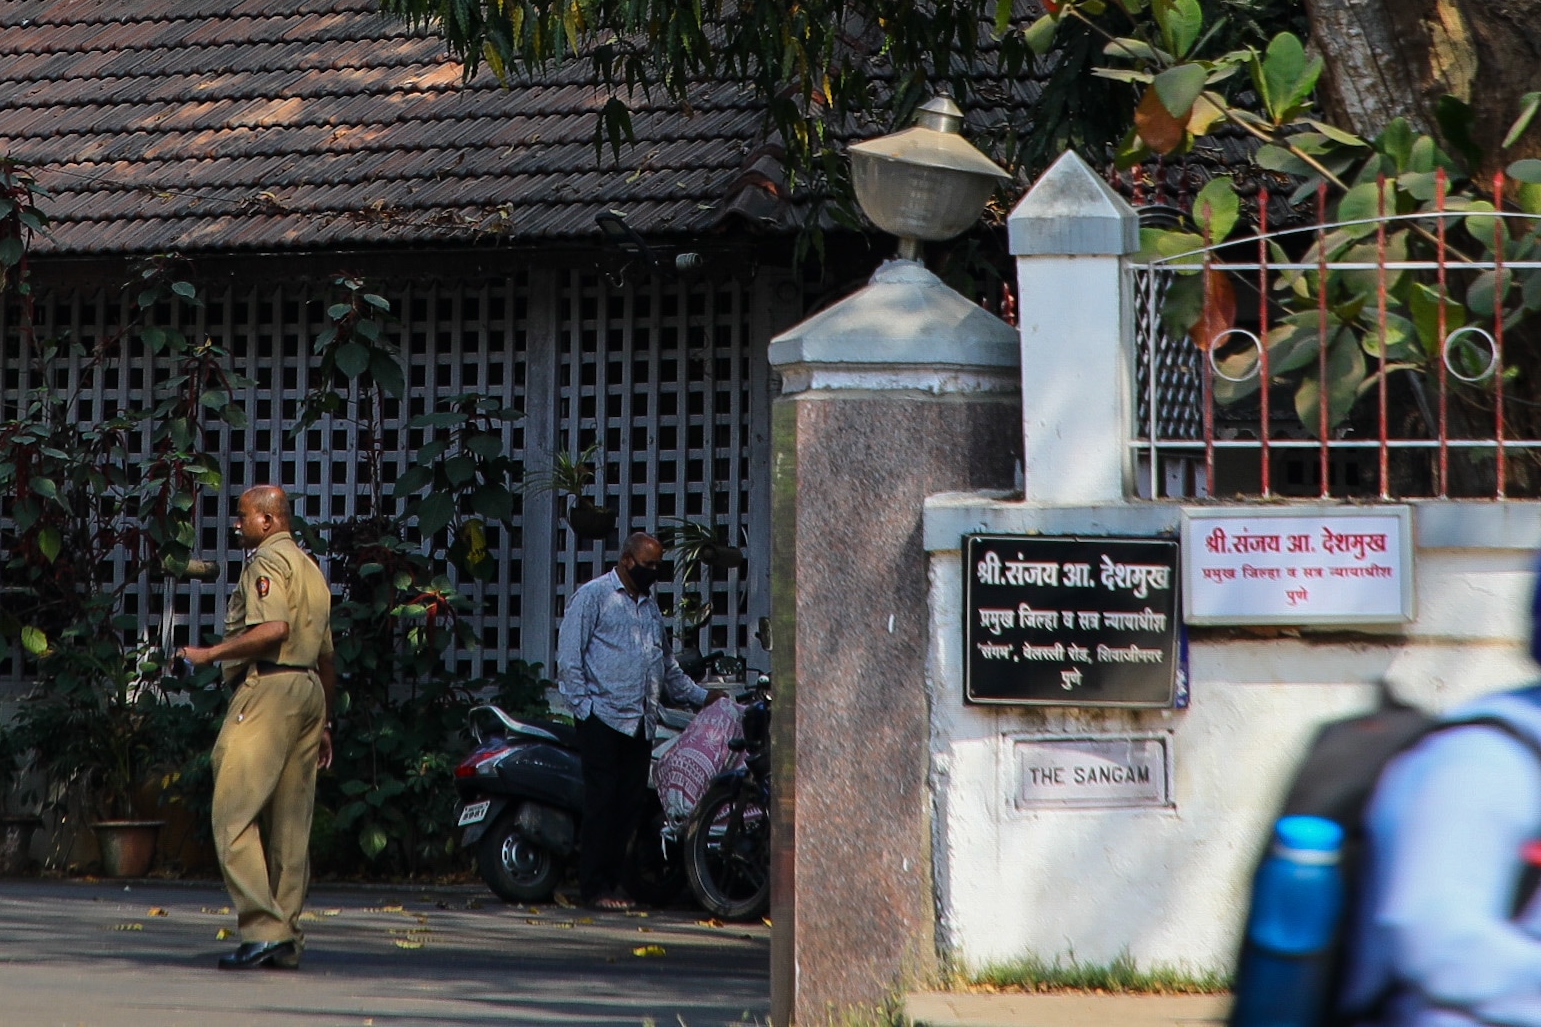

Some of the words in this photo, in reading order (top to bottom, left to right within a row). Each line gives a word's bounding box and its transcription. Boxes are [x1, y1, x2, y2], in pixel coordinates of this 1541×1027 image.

[1287, 534, 1315, 553] आ.
[1322, 527, 1387, 559] देशमुख
[1062, 563, 1095, 588] आ.
[1100, 554, 1171, 599] देशमुख
[1202, 567, 1236, 583] प्रमुख
[1286, 586, 1309, 606] पुणे
[978, 607, 1015, 636] प्रमुख
[1018, 602, 1059, 632] जिल्हा
[1061, 611, 1075, 630] व
[1060, 666, 1083, 692] पुणे
[1029, 766, 1066, 786] THE
[1073, 764, 1150, 784] SANGAM
